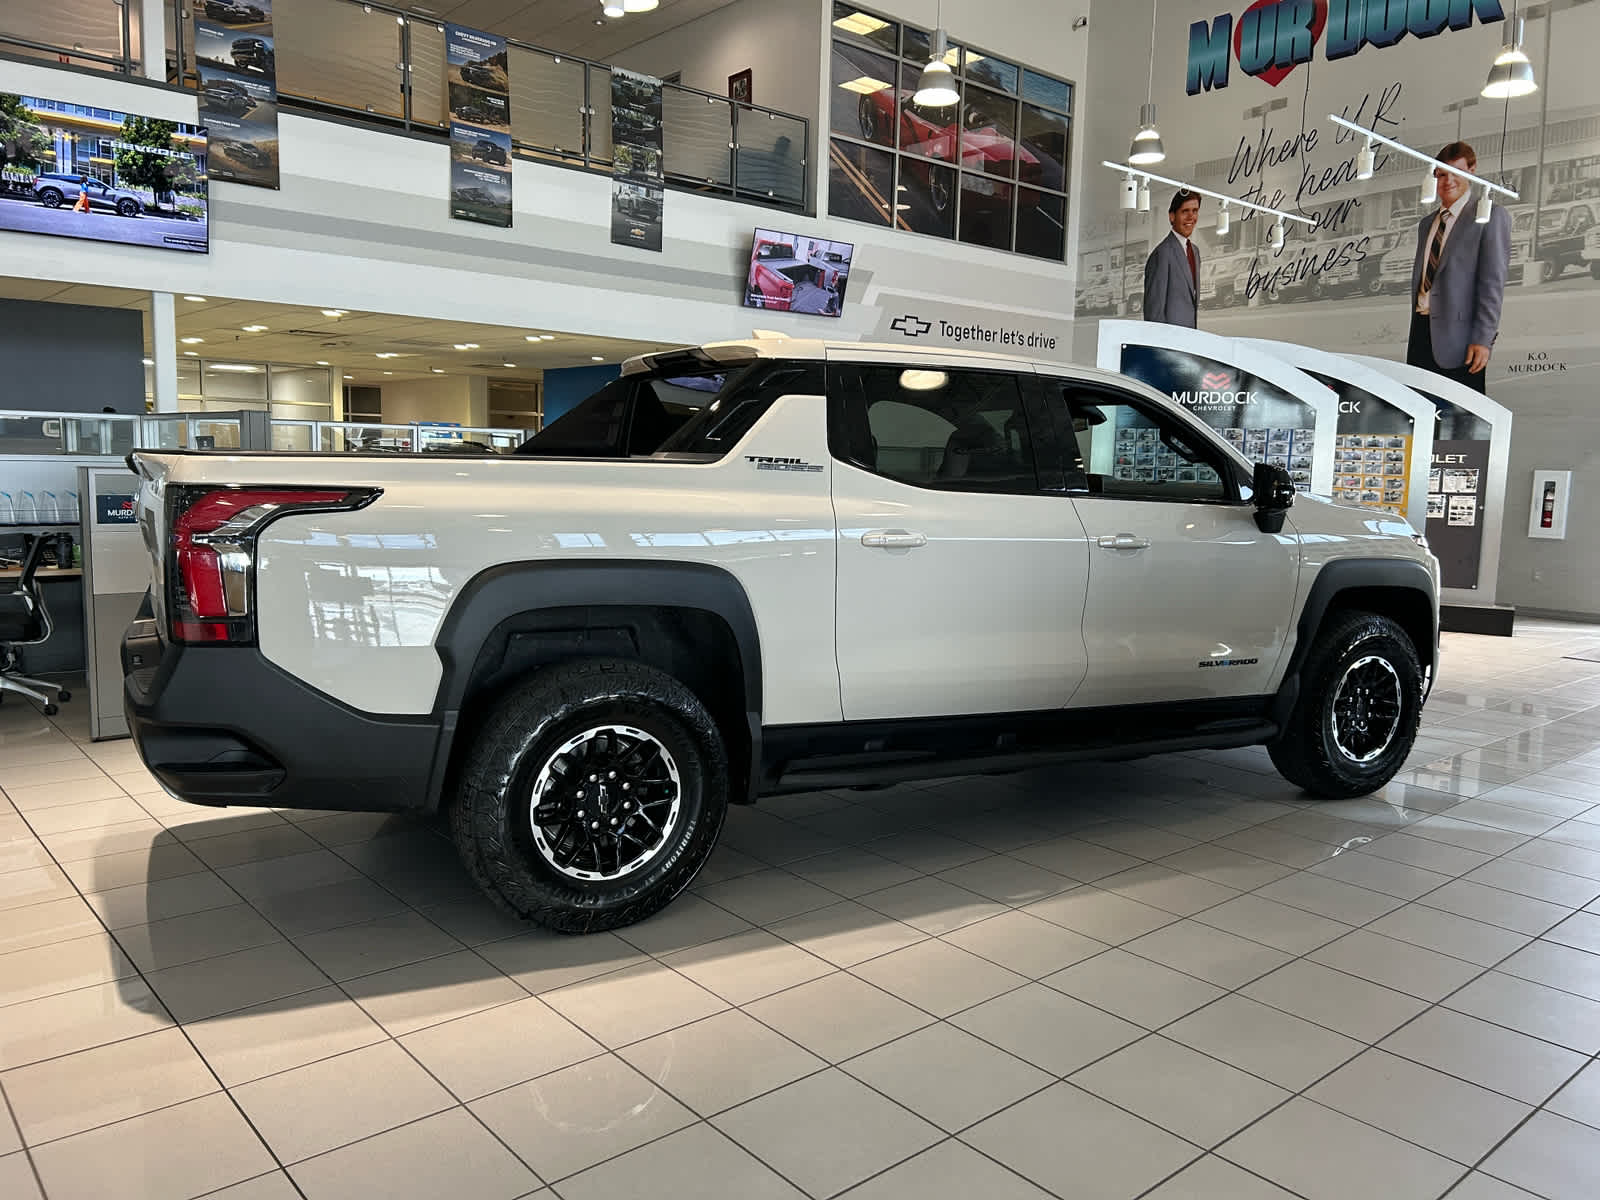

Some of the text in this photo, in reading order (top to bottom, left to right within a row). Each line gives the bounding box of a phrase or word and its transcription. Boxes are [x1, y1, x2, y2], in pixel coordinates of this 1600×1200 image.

[1228, 128, 1319, 184] Where
[1240, 136, 1399, 222] the heat
[1308, 197, 1361, 233] our
[1245, 236, 1370, 299] business
[939, 320, 998, 343] Together
[1027, 334, 1056, 349] drive
[1508, 362, 1567, 373] MURDOCK
[1172, 391, 1259, 404] MURDOCK
[744, 455, 809, 465] TRAIL
[1198, 658, 1258, 668] SILVERADO
